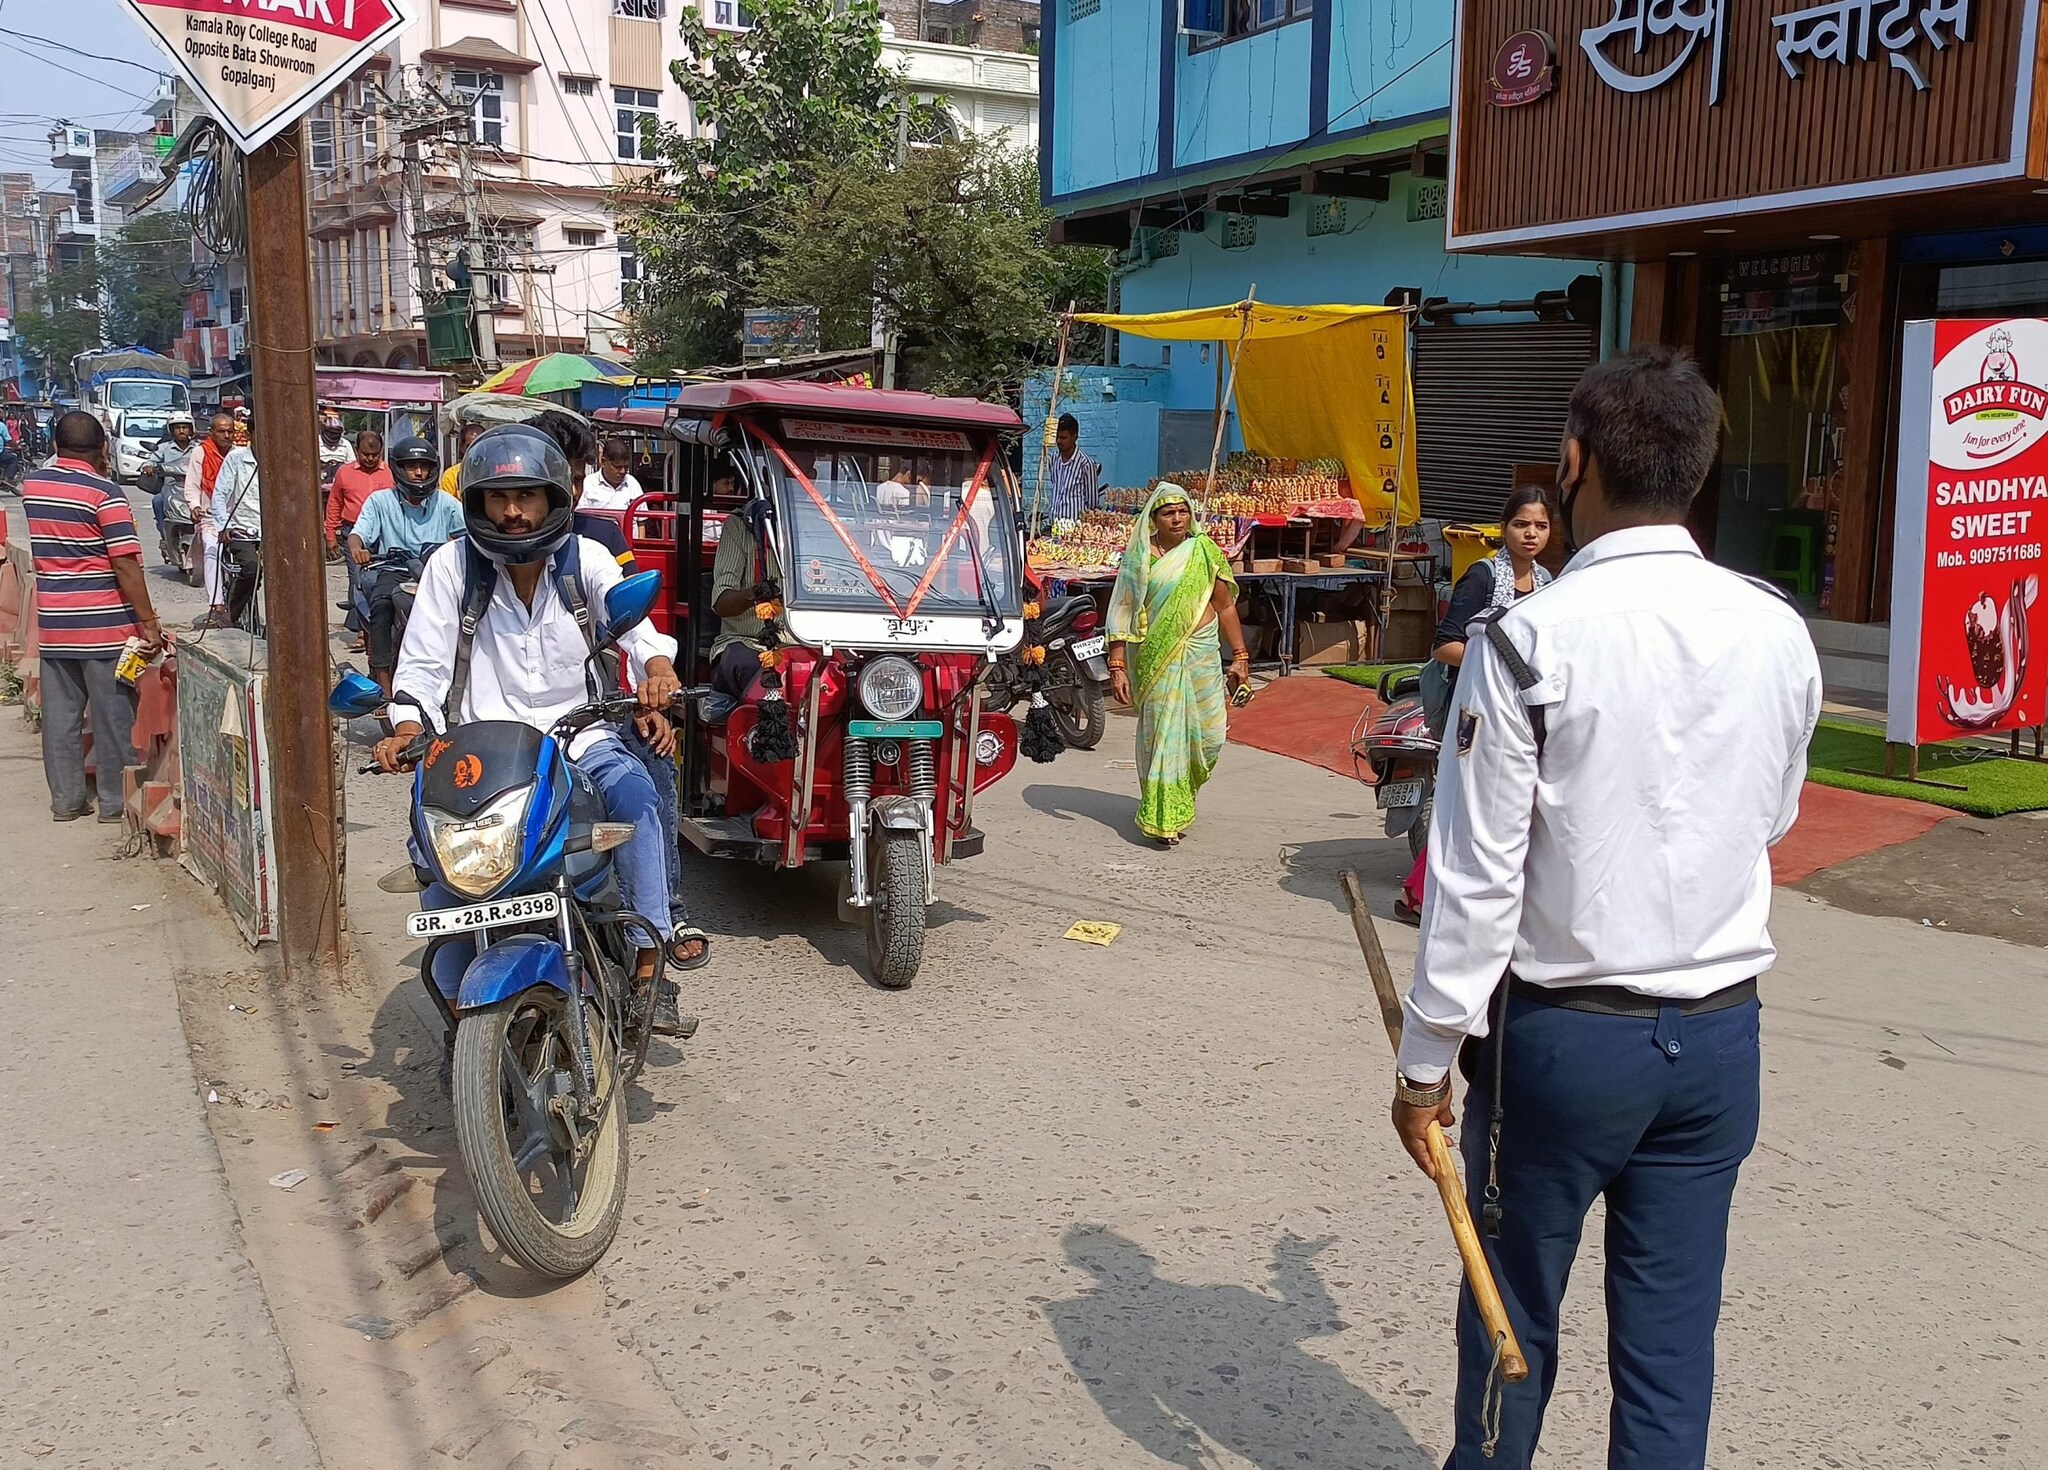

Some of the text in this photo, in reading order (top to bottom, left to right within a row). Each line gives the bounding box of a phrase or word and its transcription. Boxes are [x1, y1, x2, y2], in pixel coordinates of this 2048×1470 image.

[186, 14, 317, 53] Kamala Roy College Road
[185, 37, 316, 76] Opposite Bata Showroom
[221, 66, 276, 93] Gopalganj
[1739, 255, 1811, 277] WELCOME
[1948, 385, 2046, 416] DAIRY FUN
[1963, 419, 2026, 449] fun for every one
[494, 463, 524, 474] JADE
[1935, 475, 2048, 506] SANDHYA
[1950, 511, 2032, 540] SWEET
[1937, 542, 2041, 568] Mob. 9097511686
